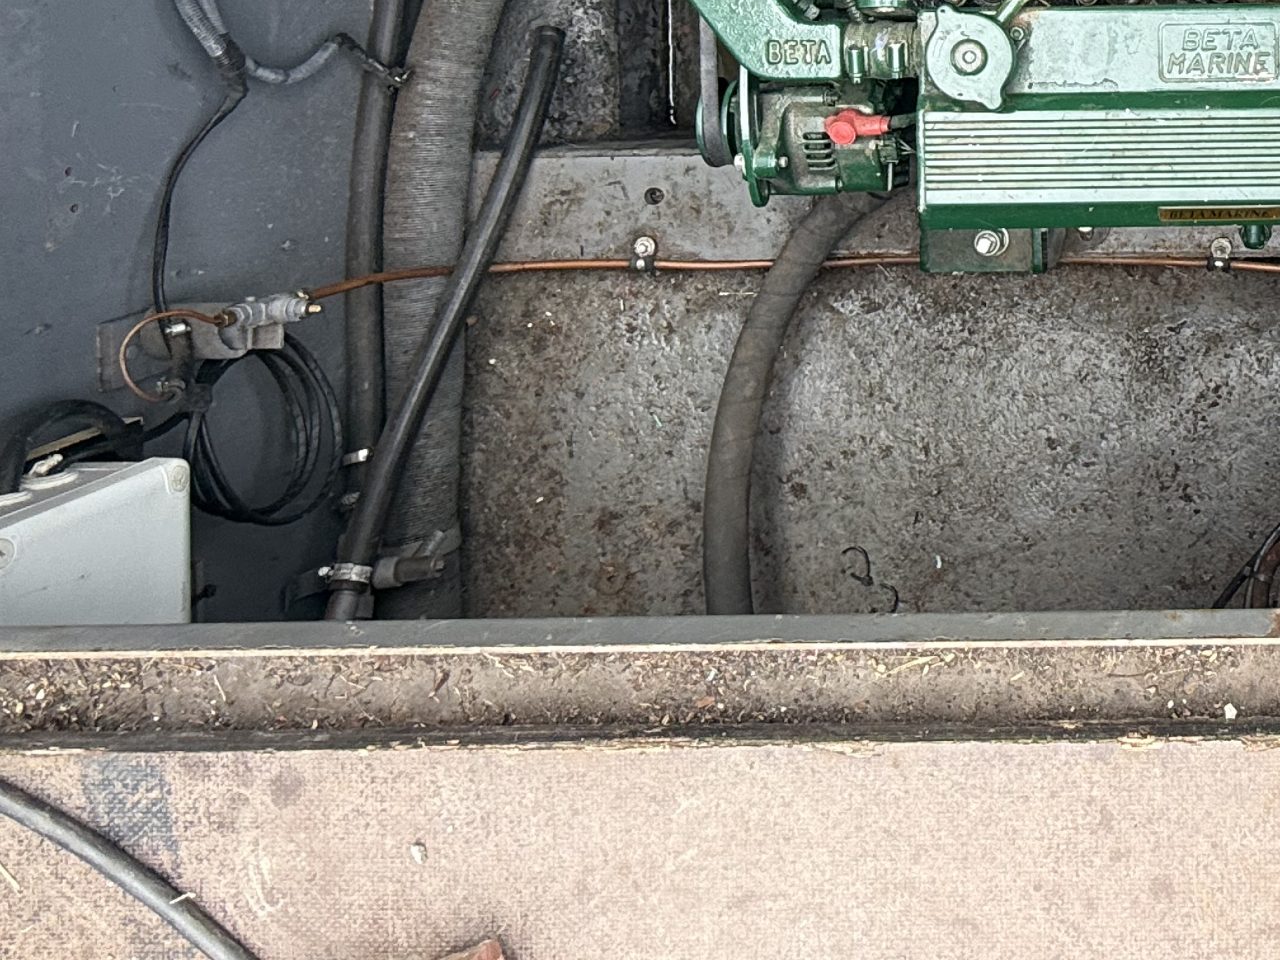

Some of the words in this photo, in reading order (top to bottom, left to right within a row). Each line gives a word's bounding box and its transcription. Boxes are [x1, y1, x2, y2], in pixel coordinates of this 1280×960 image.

[1181, 28, 1259, 51] BETA
[765, 39, 832, 65] BETA
[1166, 51, 1271, 75] MARINE
